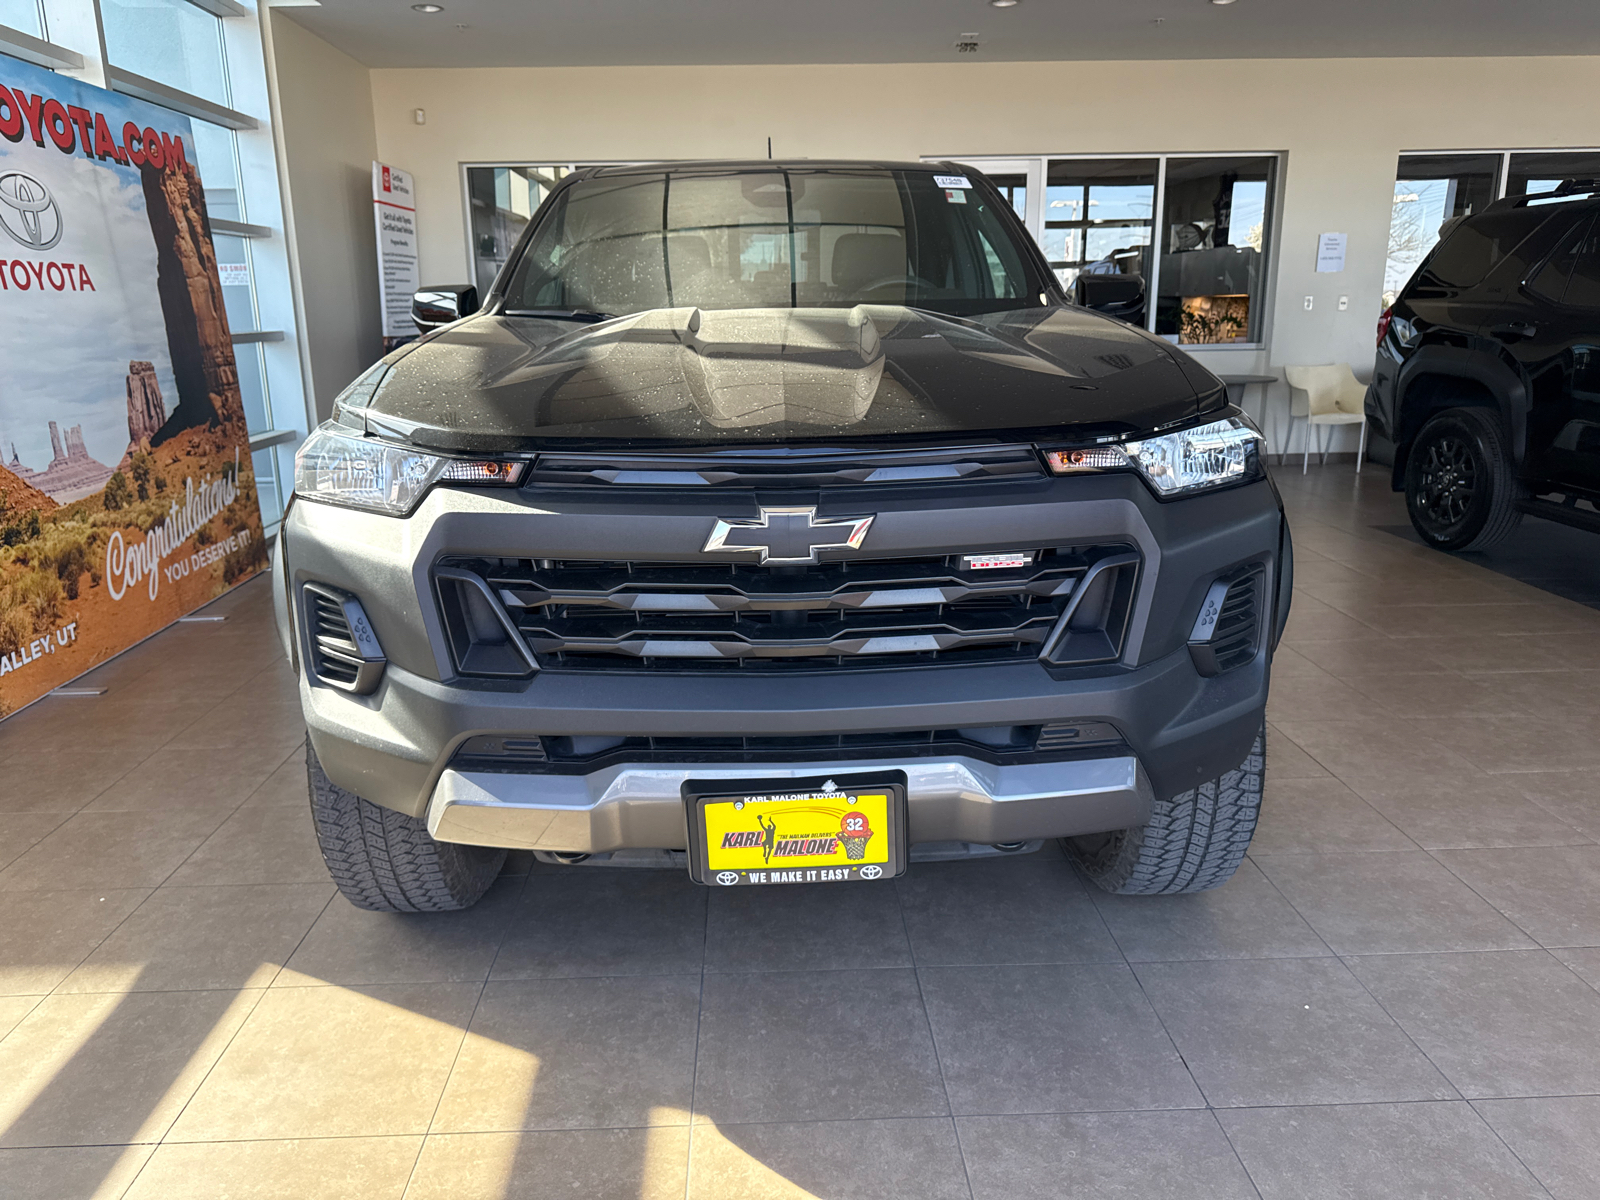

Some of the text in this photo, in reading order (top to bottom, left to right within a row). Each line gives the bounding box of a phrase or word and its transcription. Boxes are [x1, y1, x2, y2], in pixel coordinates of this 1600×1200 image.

[0, 259, 96, 291] TOYOTA
[106, 445, 241, 602] Congratulations!
[164, 558, 190, 584] YOU
[191, 535, 238, 572] DESERVE
[0, 622, 77, 677] ALLEY, UT
[743, 791, 847, 804] KARL MALONE TOYOTA
[846, 817, 864, 831] 32
[720, 831, 764, 849] KARL
[773, 838, 839, 857] MALONE
[749, 868, 850, 884] WE MAKE IT EASY
